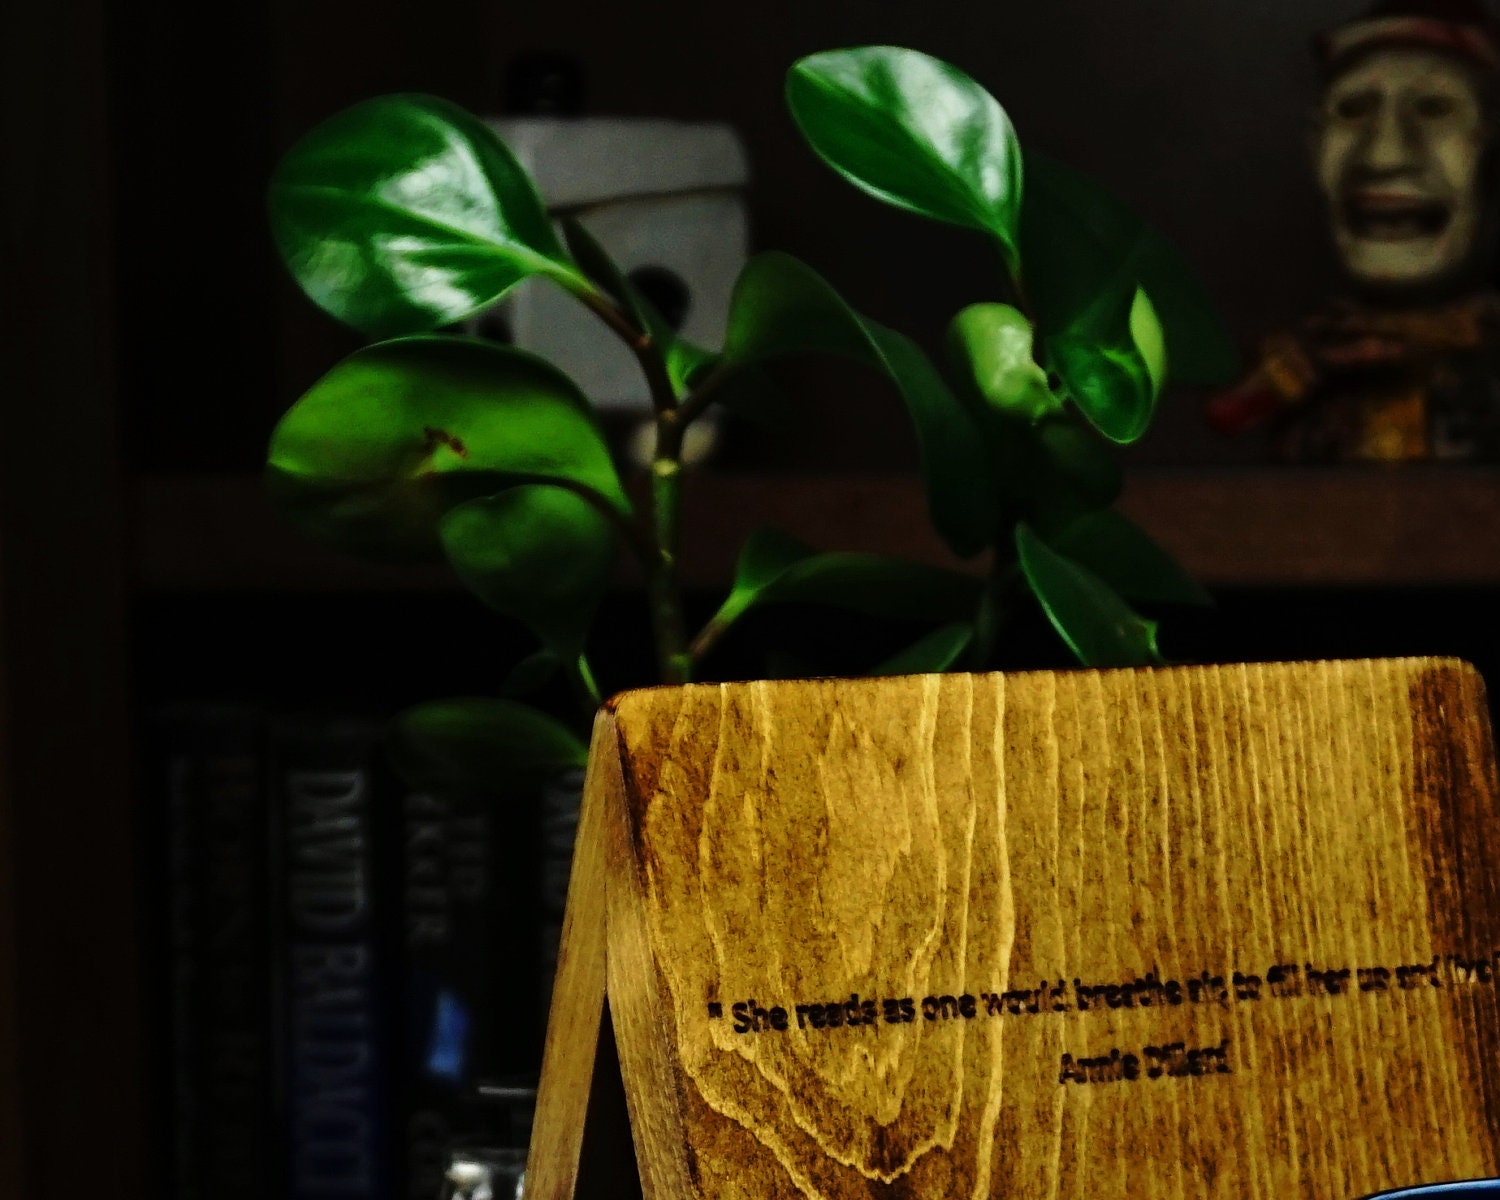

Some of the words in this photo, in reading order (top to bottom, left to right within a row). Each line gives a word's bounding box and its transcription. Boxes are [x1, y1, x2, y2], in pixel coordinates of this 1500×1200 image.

[286, 766, 377, 934] DAVID
[732, 1000, 788, 1033] She
[796, 993, 877, 1030] reads
[884, 998, 914, 1022] as
[921, 994, 977, 1020] one
[981, 980, 1067, 1015] would
[1073, 971, 1181, 1012] breathe
[1233, 971, 1262, 1000] to
[1305, 962, 1350, 994] her
[1396, 954, 1440, 989] and
[290, 940, 380, 1199] BALDACCI
[1058, 1048, 1139, 1084] Annie
